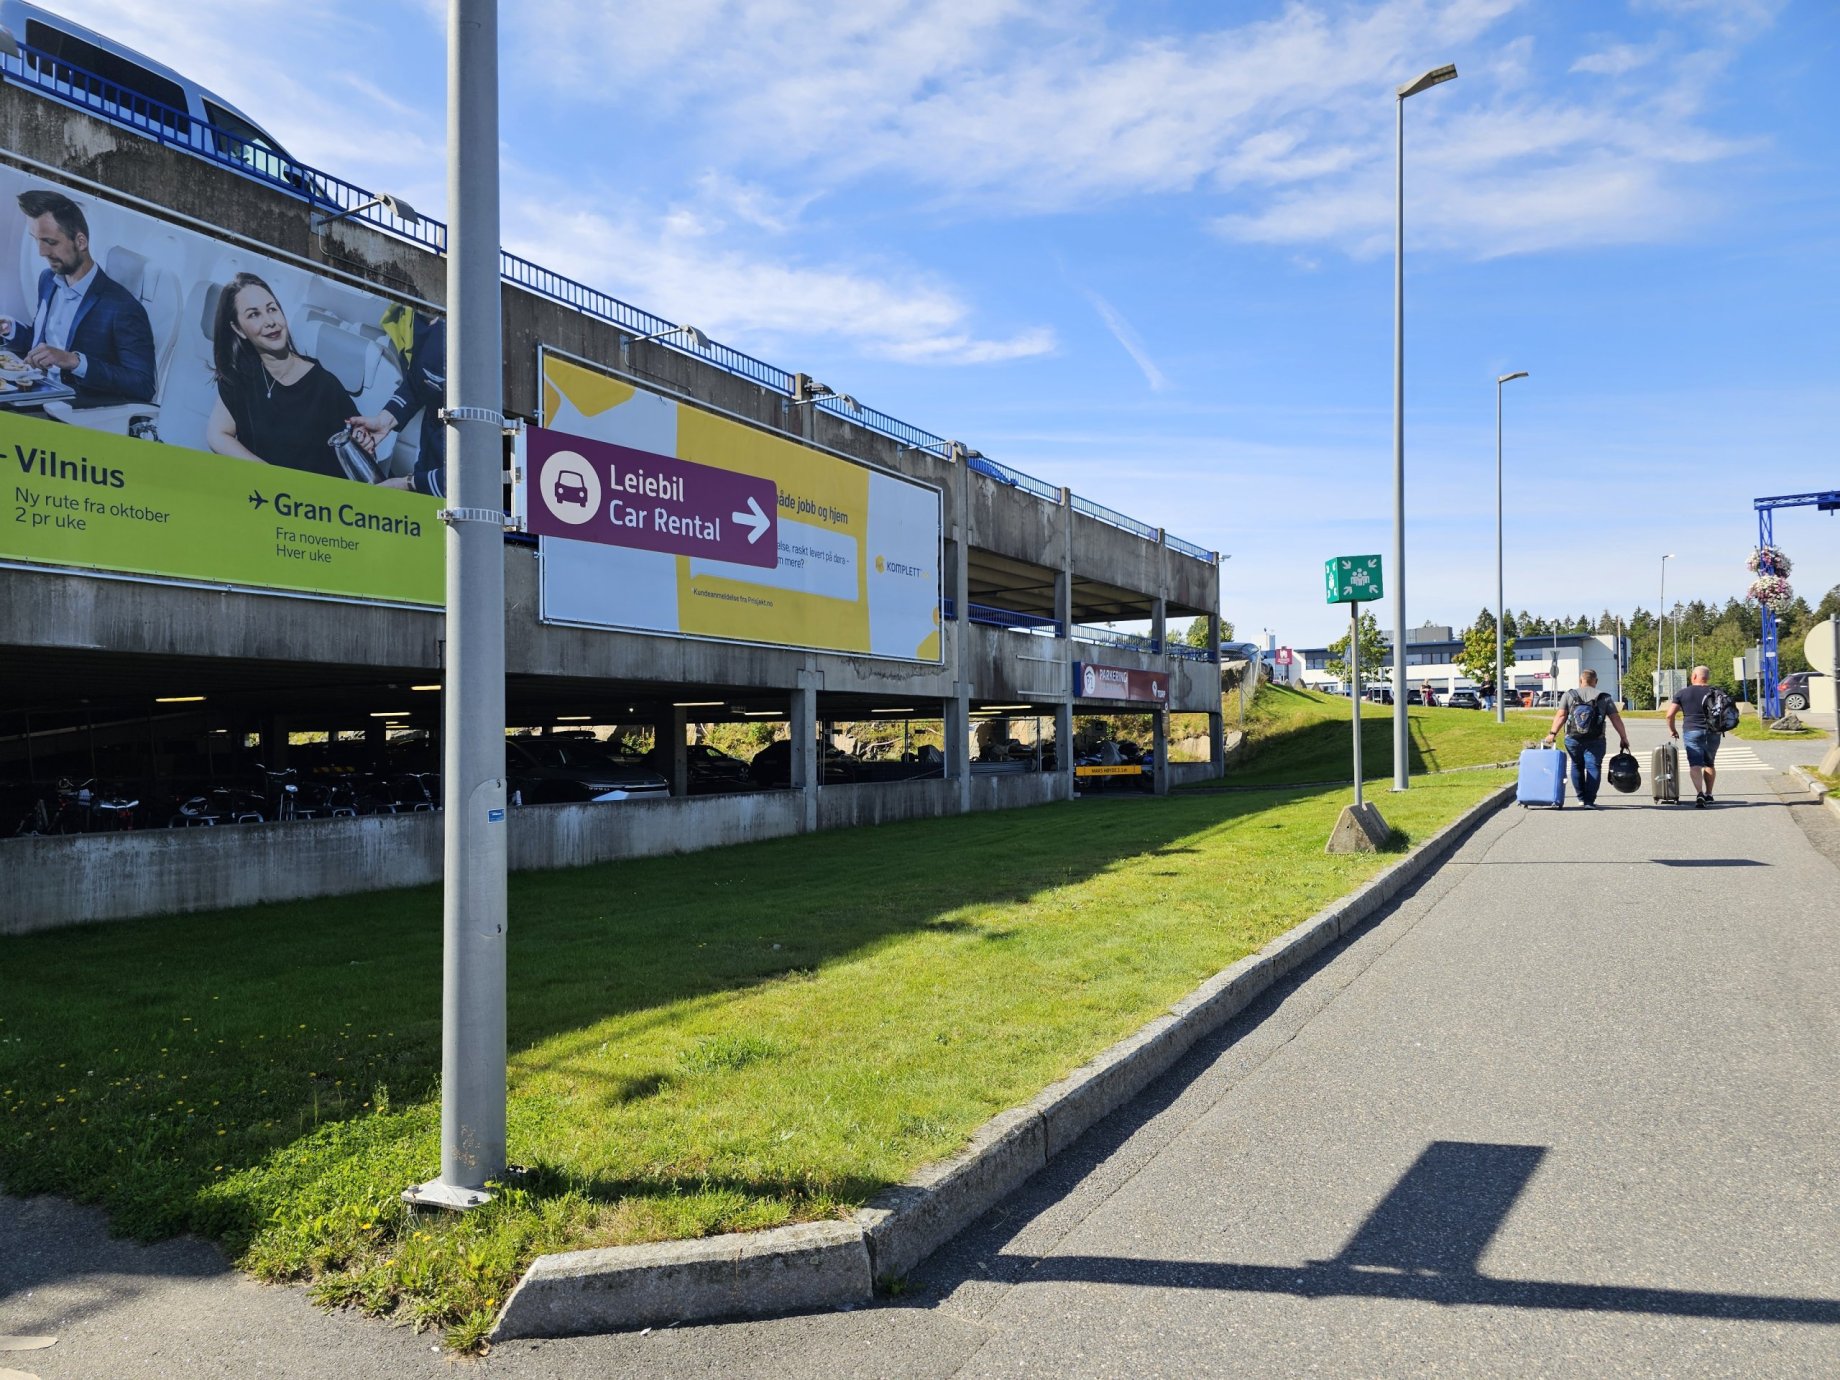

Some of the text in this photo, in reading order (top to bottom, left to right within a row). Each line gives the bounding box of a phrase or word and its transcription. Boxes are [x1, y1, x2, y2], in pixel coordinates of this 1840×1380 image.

[15, 445, 125, 488] Vilnius
[610, 464, 684, 502] Leiebil
[15, 507, 86, 530] 2 pr uke
[16, 486, 170, 523] Ny rute fra oktober
[274, 493, 421, 537] Gran Canaria
[776, 490, 848, 524] åde jobb og hjem
[610, 500, 720, 542] Car Rental
[276, 527, 360, 550] Fra november
[792, 545, 808, 556] raskt
[276, 544, 332, 563] Hver uke
[784, 558, 804, 568] mere?
[886, 561, 922, 578] KOMPLETT
